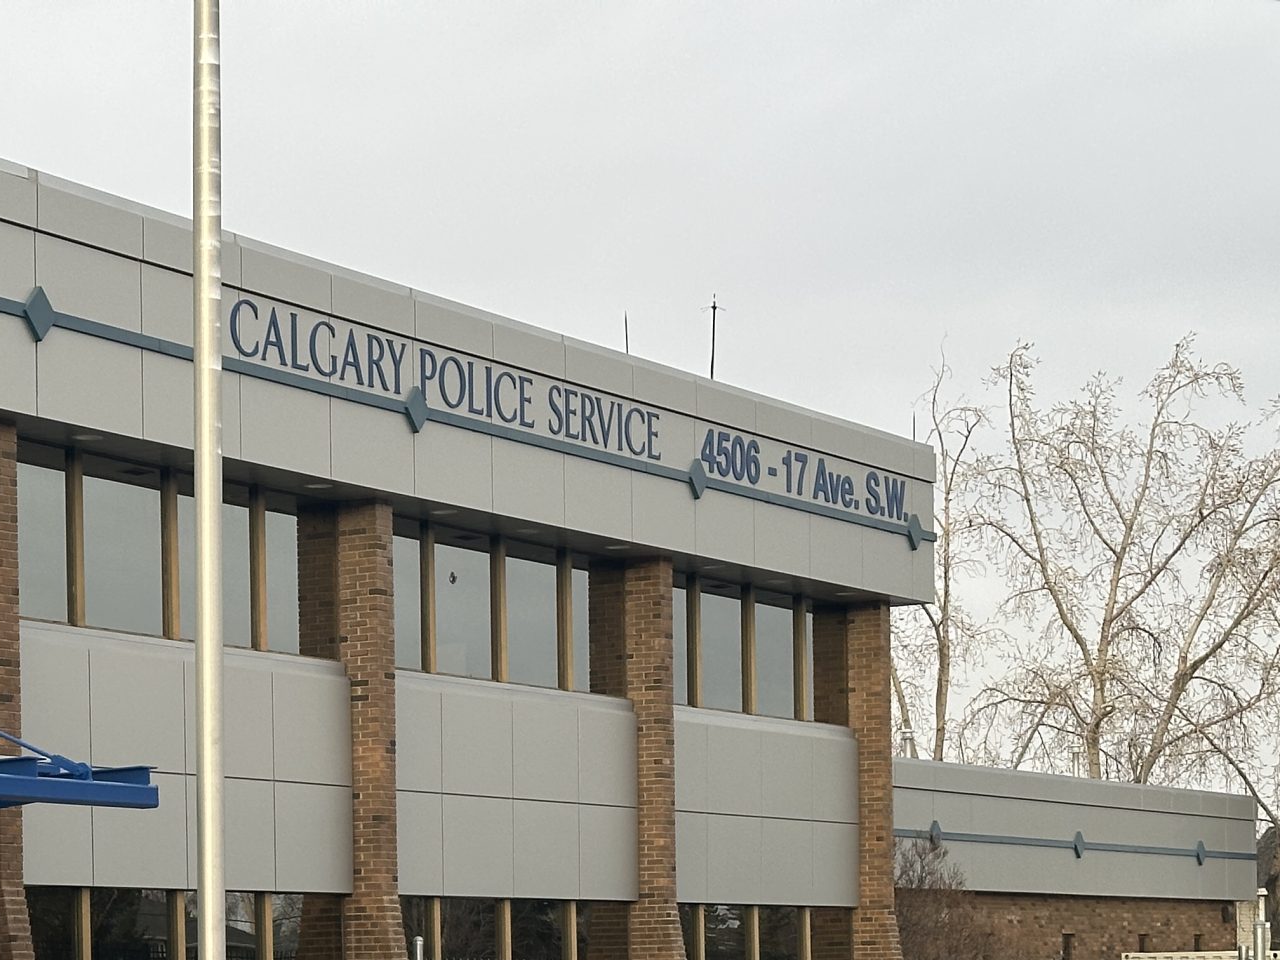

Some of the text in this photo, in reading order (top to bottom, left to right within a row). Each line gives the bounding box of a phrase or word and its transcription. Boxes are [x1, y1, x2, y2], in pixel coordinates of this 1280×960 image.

[229, 299, 662, 460] CALGARY POLICE SERVICE
[701, 428, 761, 486] 4506
[782, 450, 808, 496] 17
[813, 457, 860, 510] Ave.
[865, 471, 909, 523] S.W.
